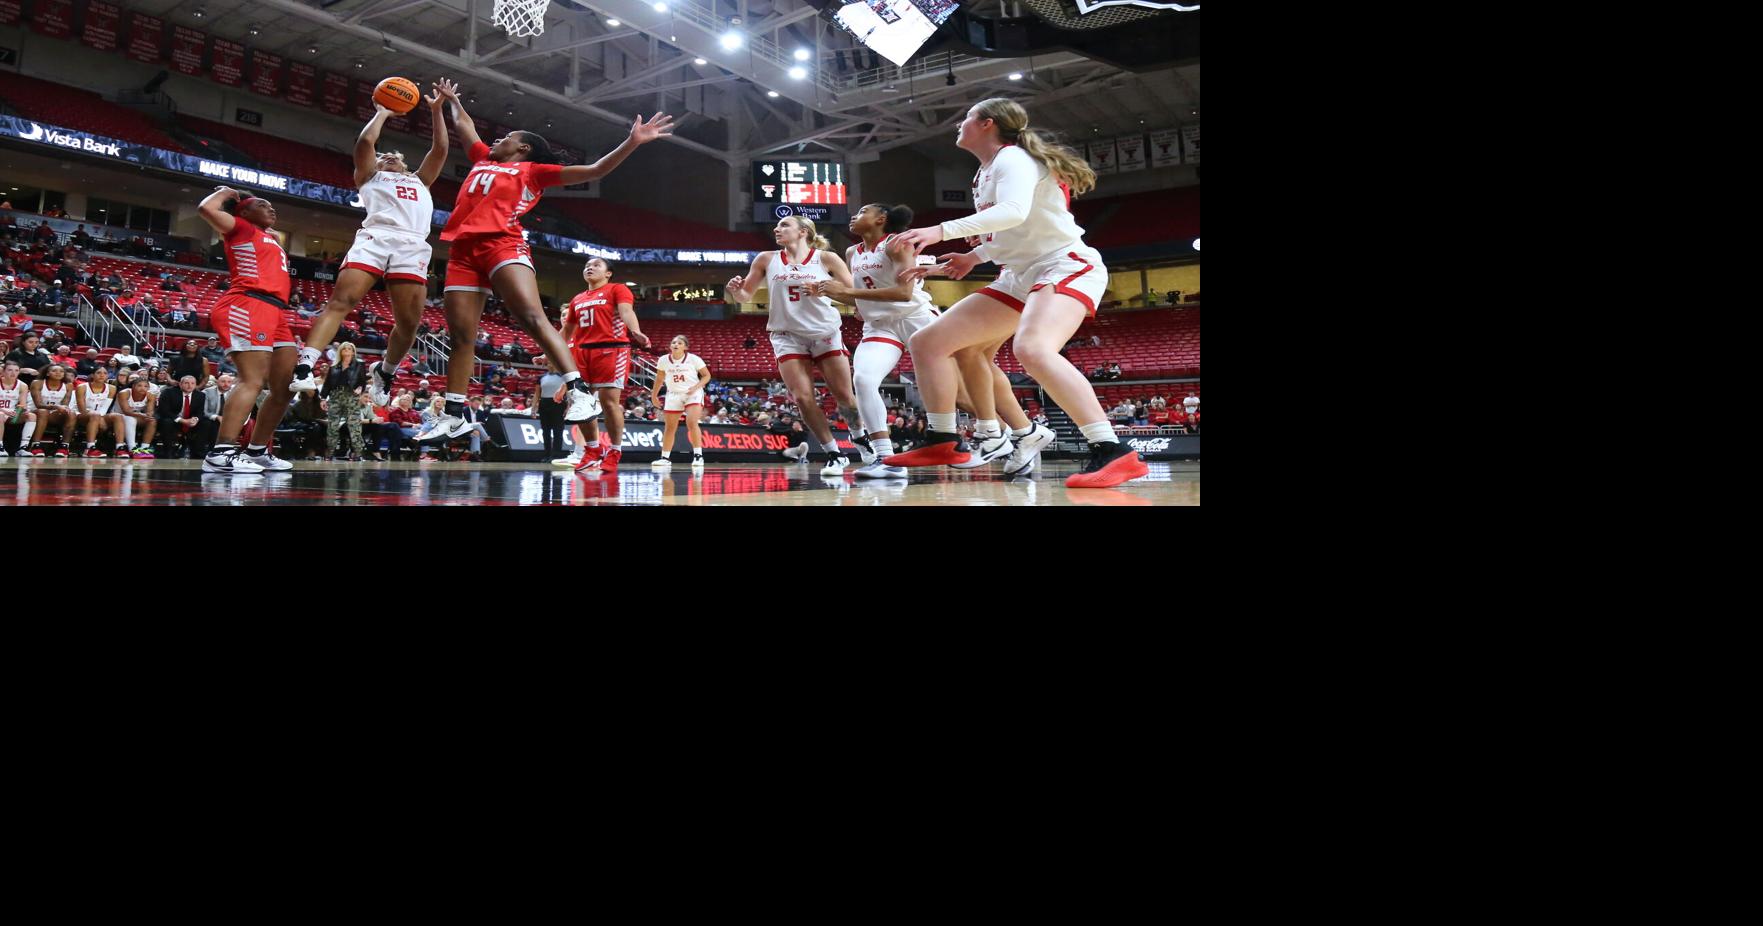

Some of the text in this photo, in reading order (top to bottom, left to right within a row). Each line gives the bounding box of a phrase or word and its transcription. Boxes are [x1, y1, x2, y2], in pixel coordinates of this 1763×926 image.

[45, 129, 121, 156] Vista Bank
[199, 161, 287, 190] MAKE YOUR MOVE
[467, 172, 497, 195] 14
[395, 185, 418, 202] 23
[796, 206, 828, 214] Western
[678, 250, 749, 264] MAKE YOUR MOVE
[789, 273, 818, 281] Raiders
[862, 275, 877, 290] 2
[788, 285, 801, 302] 5
[579, 307, 595, 329] 21
[673, 374, 686, 383] 24
[723, 433, 764, 450] ZERO
[1127, 437, 1172, 450] Coca-Cola
